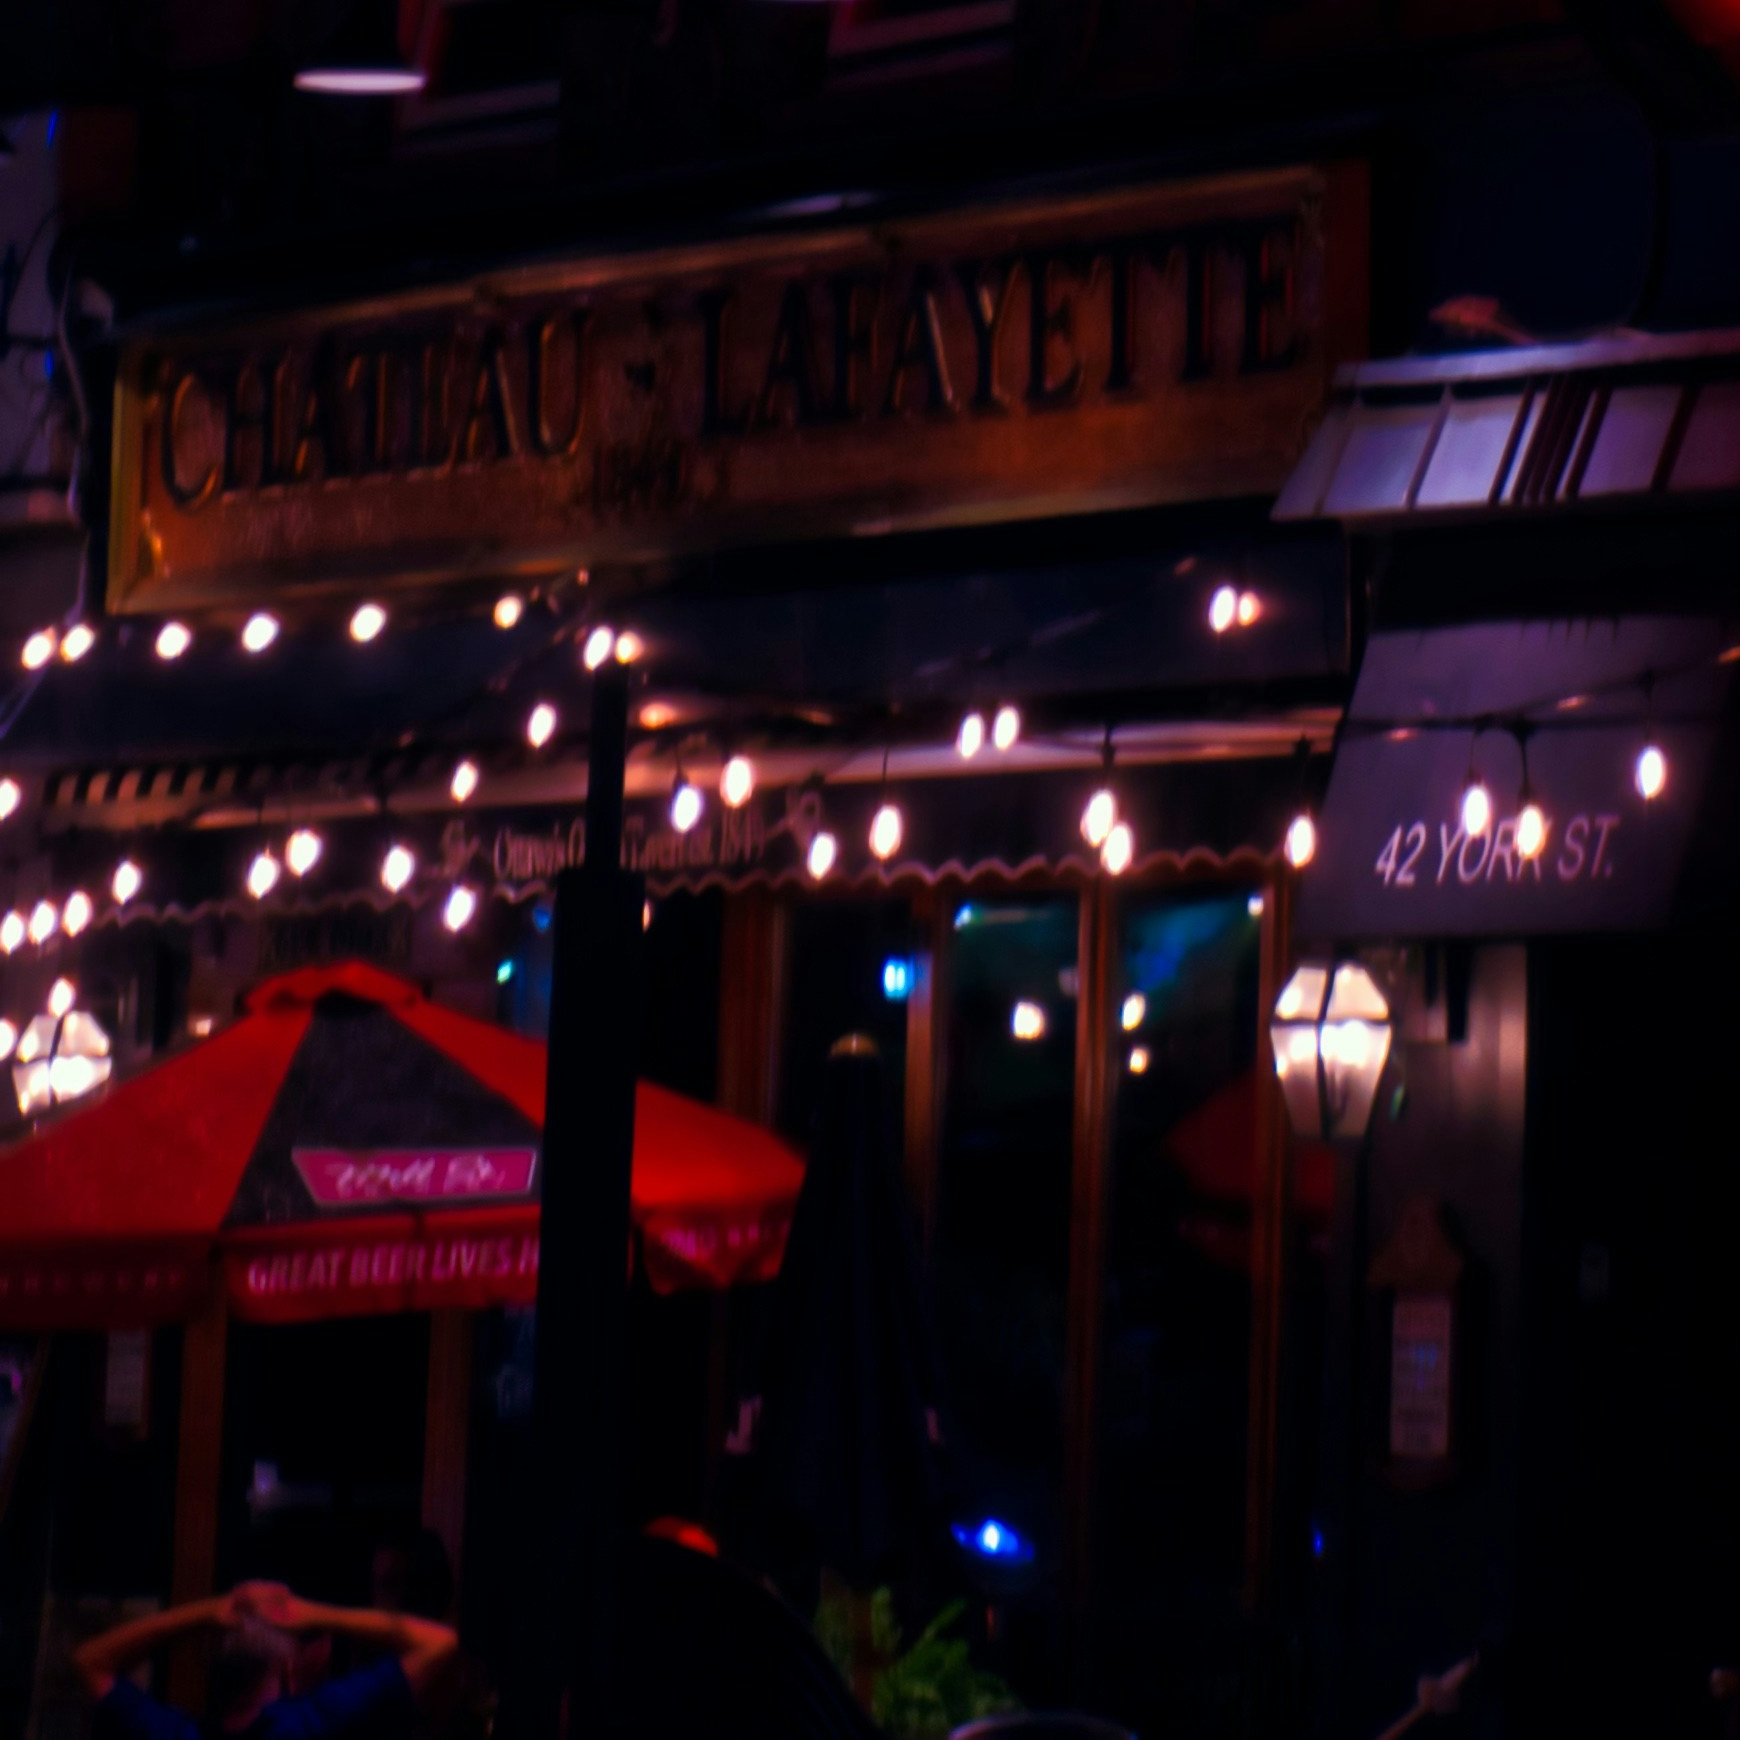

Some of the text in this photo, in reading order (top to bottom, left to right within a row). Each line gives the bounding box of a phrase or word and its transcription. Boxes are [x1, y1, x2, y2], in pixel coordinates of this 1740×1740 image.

[157, 217, 1305, 504] CHATEAU LAFAYETTE
[1376, 822, 1426, 886] 42
[1558, 815, 1620, 882] ST.
[248, 1248, 346, 1294] GREAT
[431, 1232, 512, 1280] LIVES
